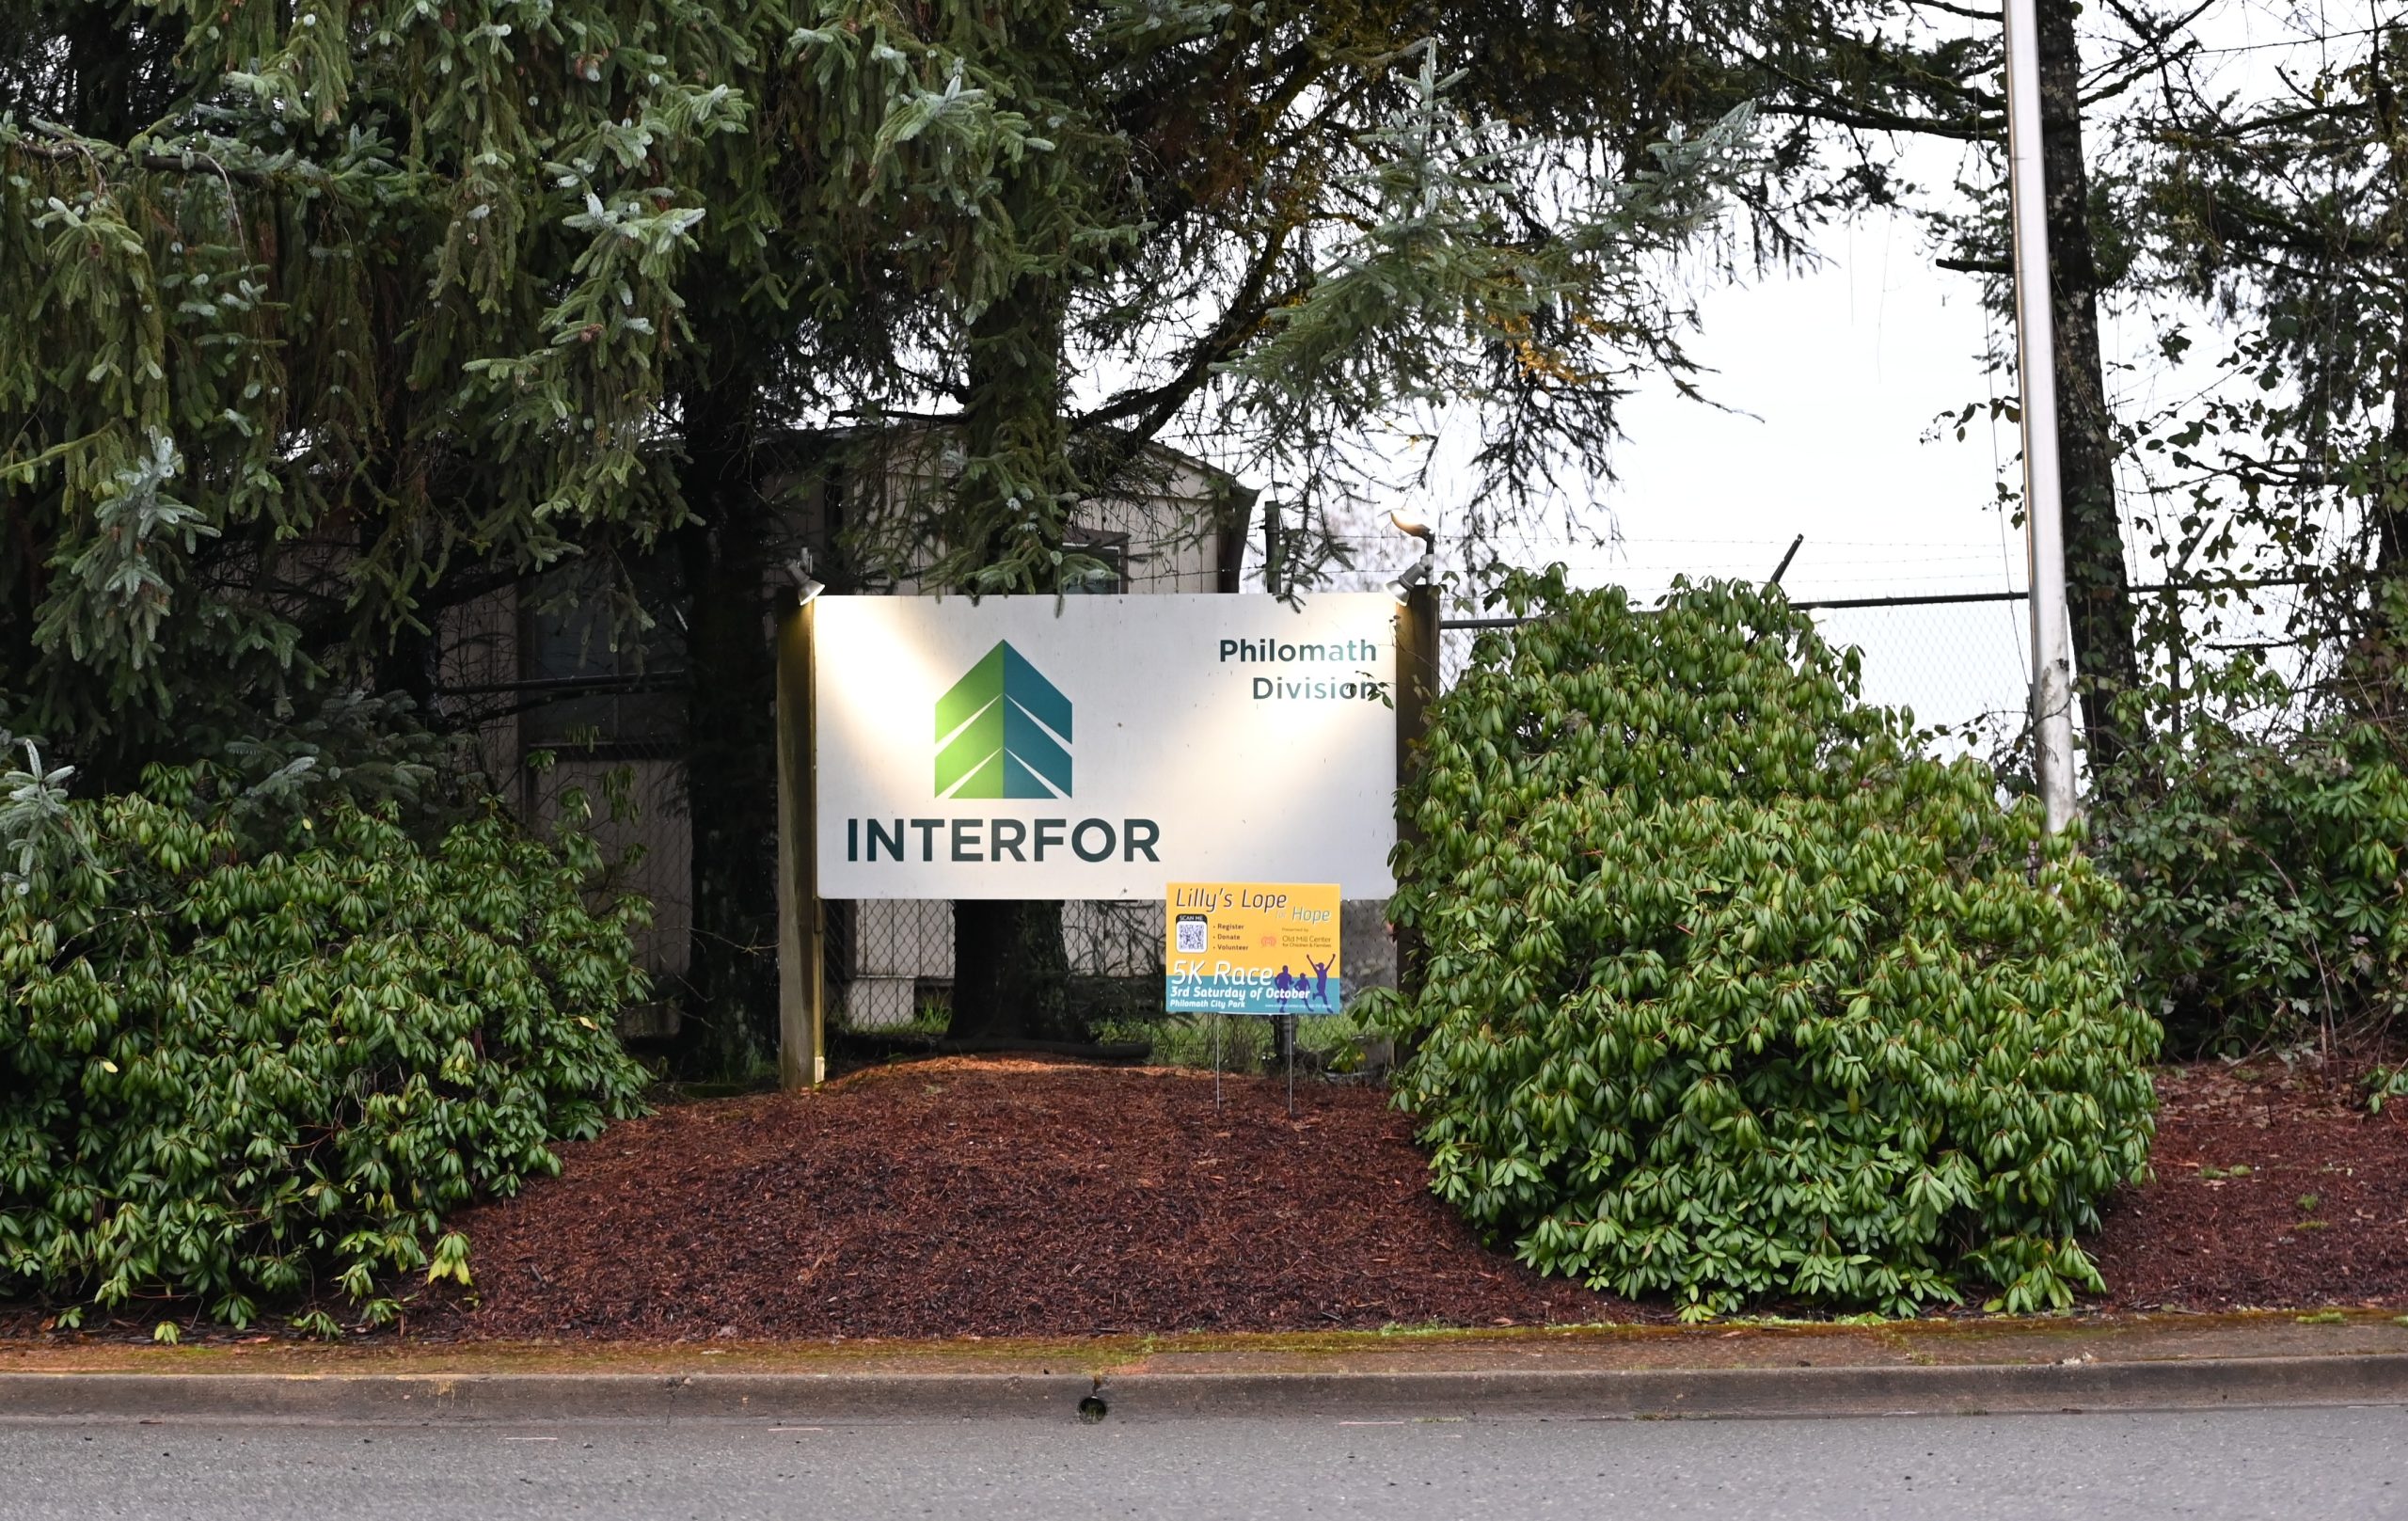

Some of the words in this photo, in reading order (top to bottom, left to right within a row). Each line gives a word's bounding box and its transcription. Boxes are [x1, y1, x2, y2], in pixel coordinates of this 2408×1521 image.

[1220, 639, 1377, 662] Philomath
[848, 817, 1161, 863] INTERFOR
[1176, 887, 1233, 912] Lilly's
[1242, 889, 1287, 913] Lope
[1292, 906, 1331, 926] Hope
[1171, 960, 1204, 986] 5K
[1213, 961, 1274, 986] Race
[1170, 999, 1209, 1007] Philomath
[1211, 1000, 1226, 1008] City
[1228, 1000, 1245, 1008] Park
[1171, 987, 1189, 997] 3rd
[1194, 987, 1245, 1001] Saturday
[1250, 987, 1262, 1001] of
[1266, 988, 1310, 999] October
